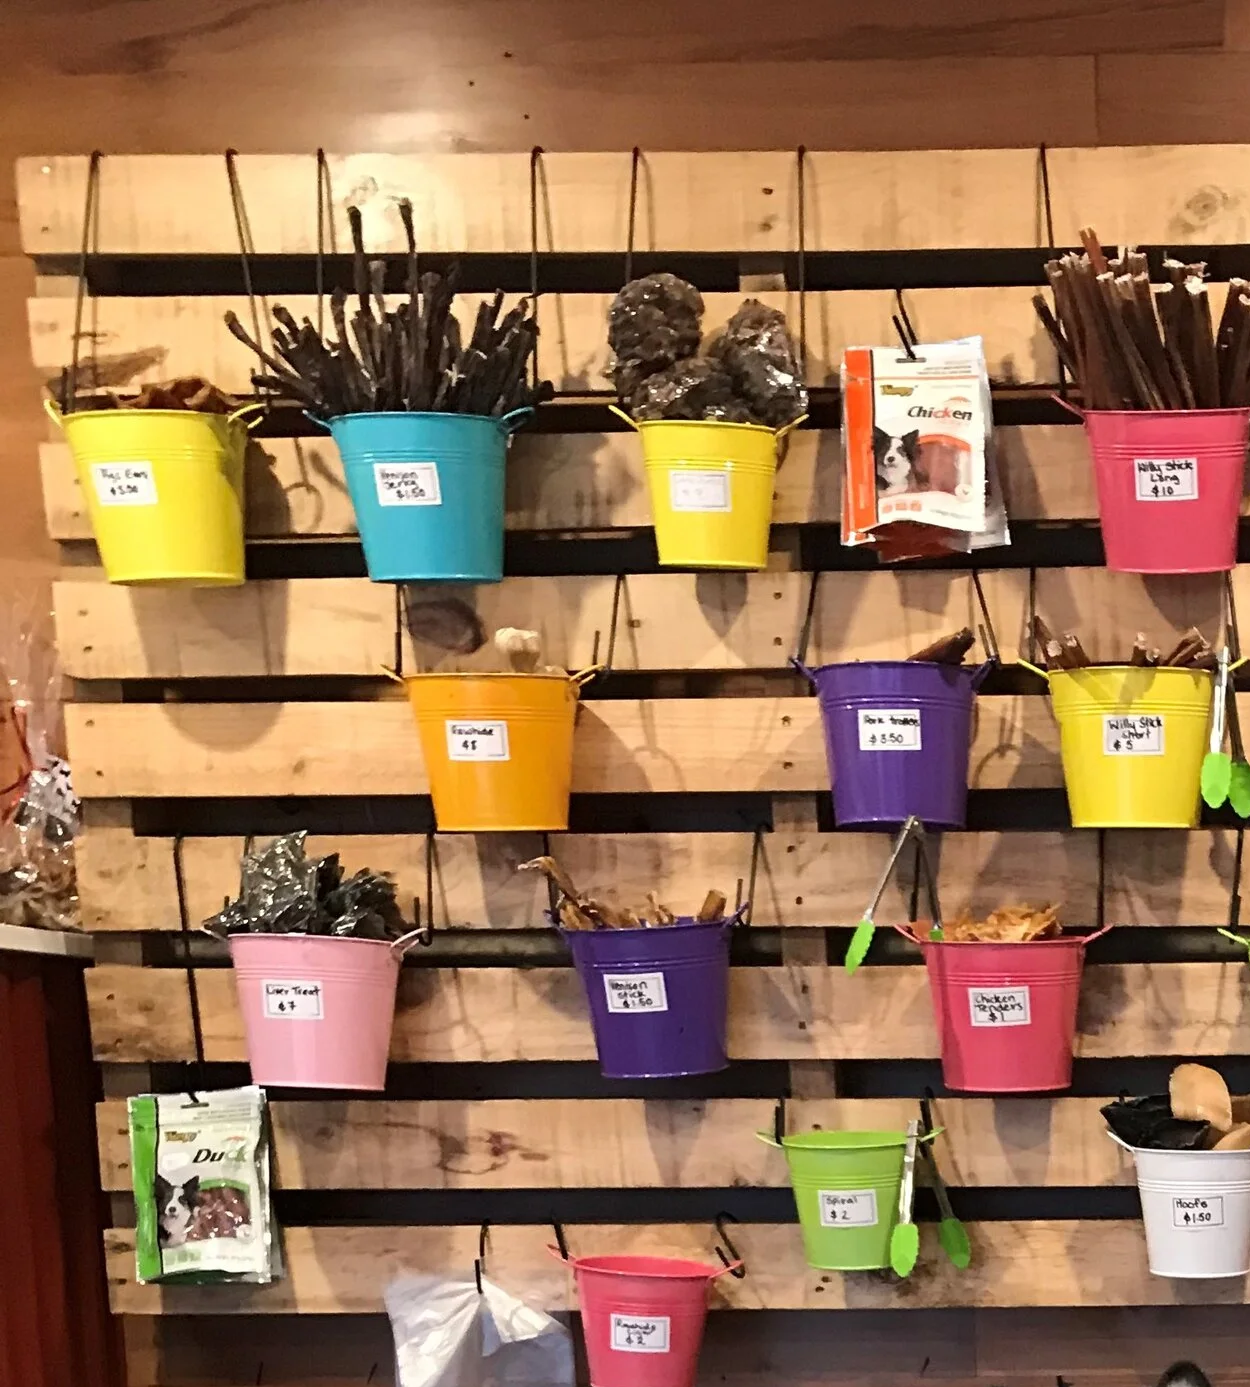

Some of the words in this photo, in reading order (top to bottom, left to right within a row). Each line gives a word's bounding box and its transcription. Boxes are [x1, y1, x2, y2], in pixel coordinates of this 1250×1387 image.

[908, 405, 973, 422] Chicken
[1137, 462, 1162, 475] Willy
[1150, 474, 1180, 485] Long
[1151, 484, 1174, 497] $10
[1107, 718, 1136, 734] Willy
[975, 993, 1016, 1004] Chicken
[1183, 1211, 1212, 1225] $1.50
